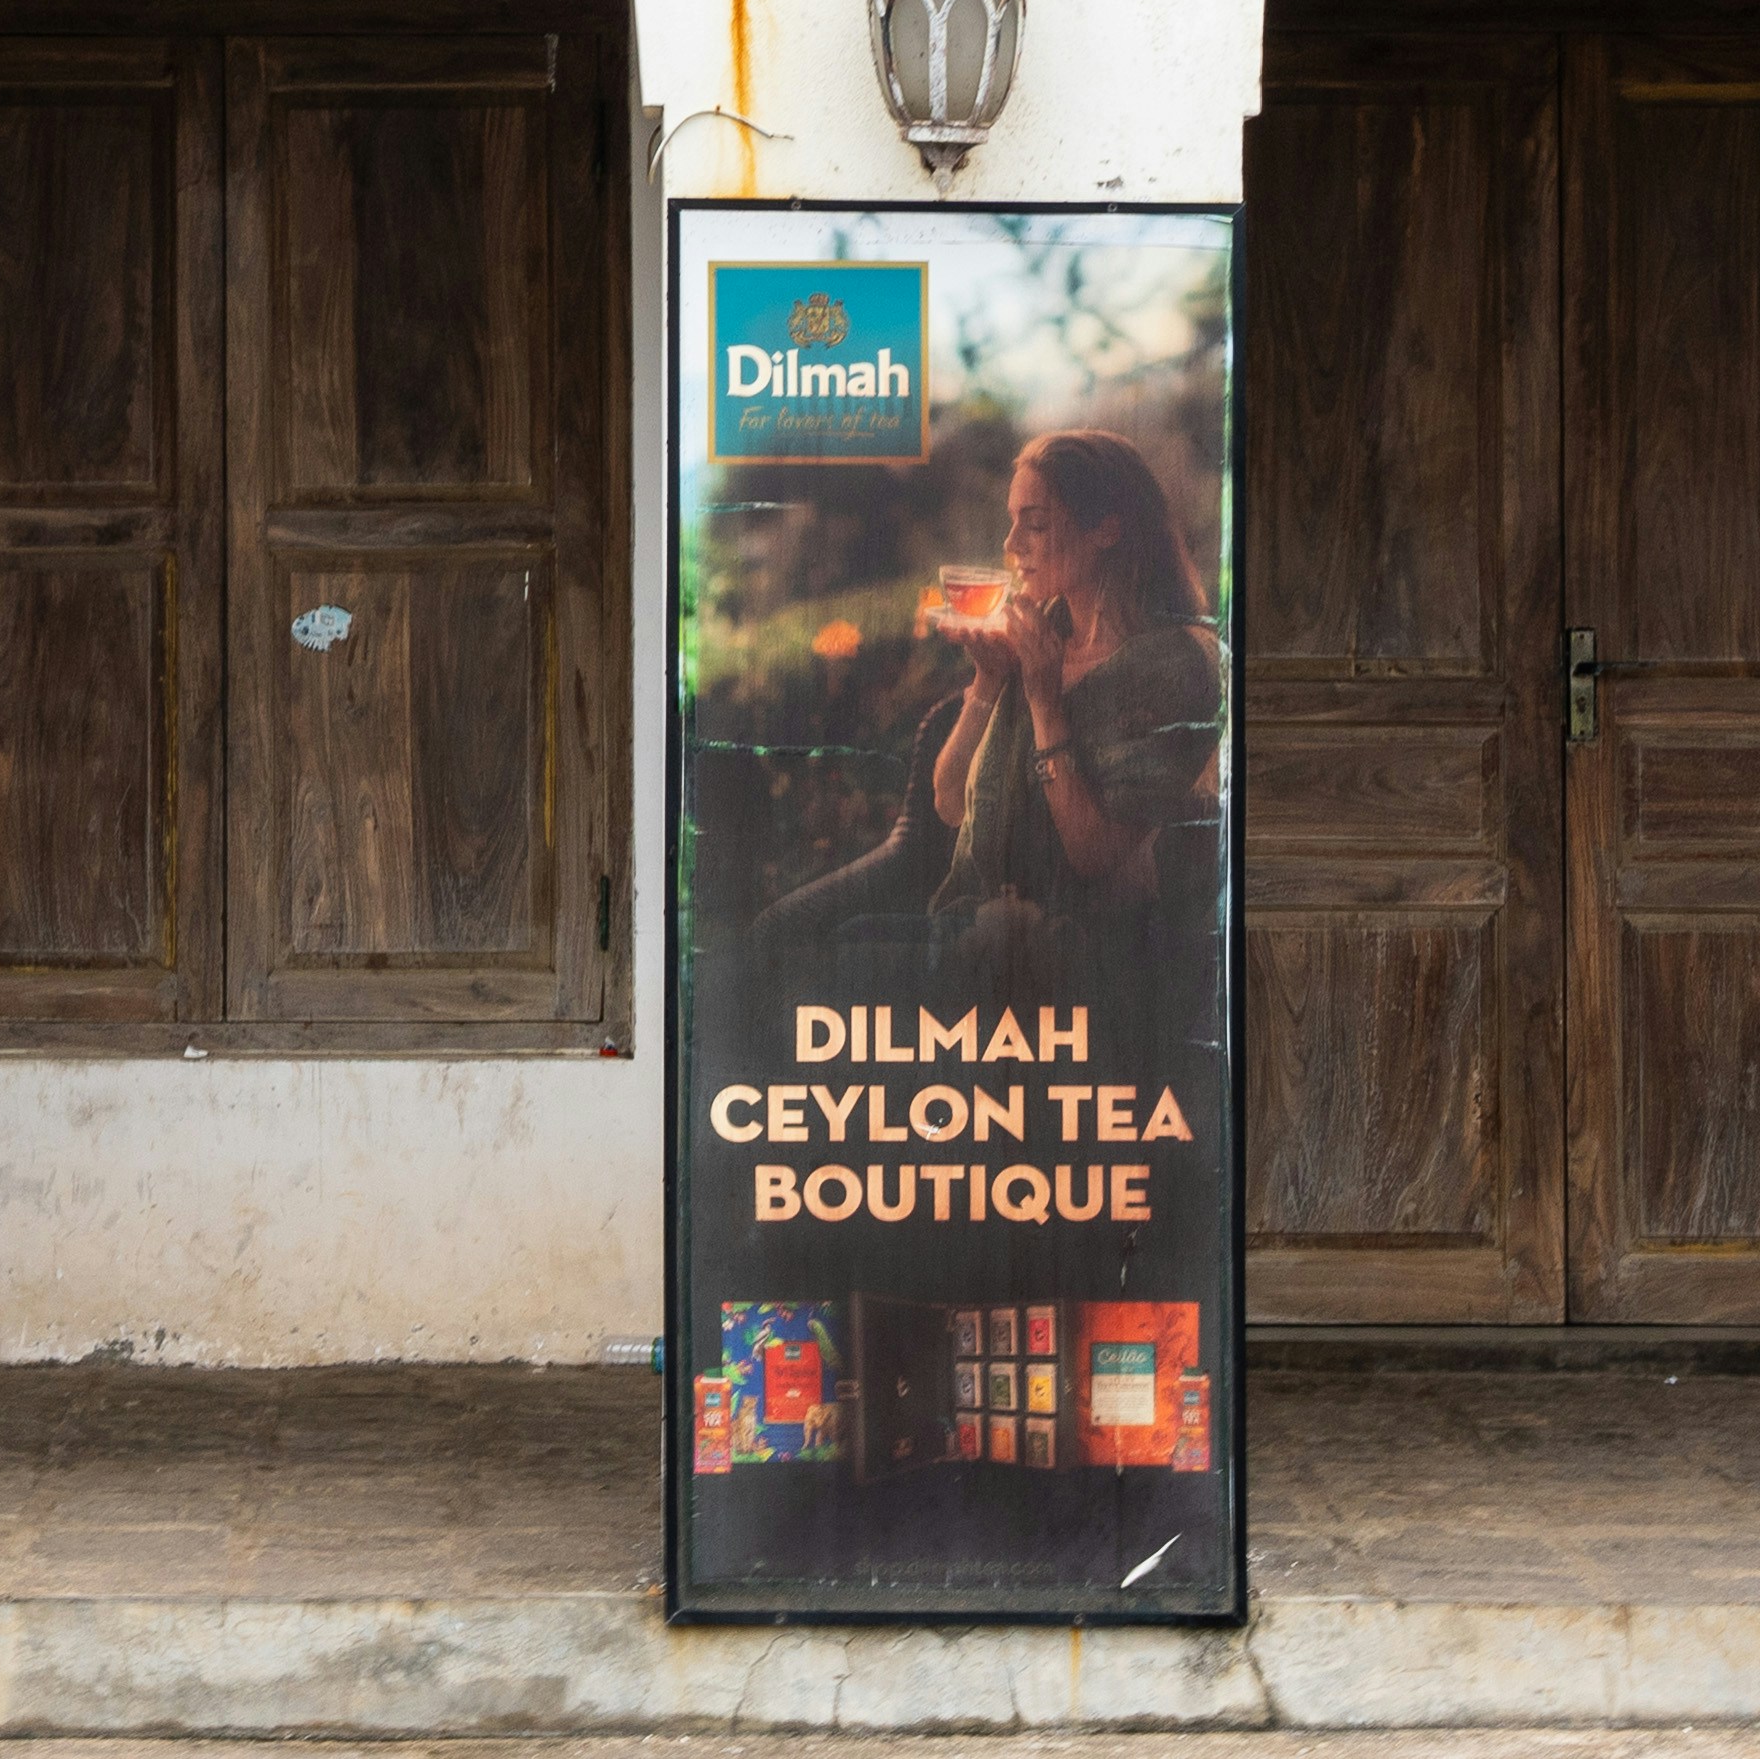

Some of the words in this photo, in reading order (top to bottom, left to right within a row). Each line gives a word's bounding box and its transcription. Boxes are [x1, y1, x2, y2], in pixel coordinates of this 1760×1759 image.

[726, 344, 910, 398] Dilmah
[795, 1005, 1088, 1063] DILMAH
[709, 1084, 1025, 1143] CEYLON
[1047, 1084, 1194, 1142] TEA
[754, 1163, 1151, 1225] BOUTIQUE
